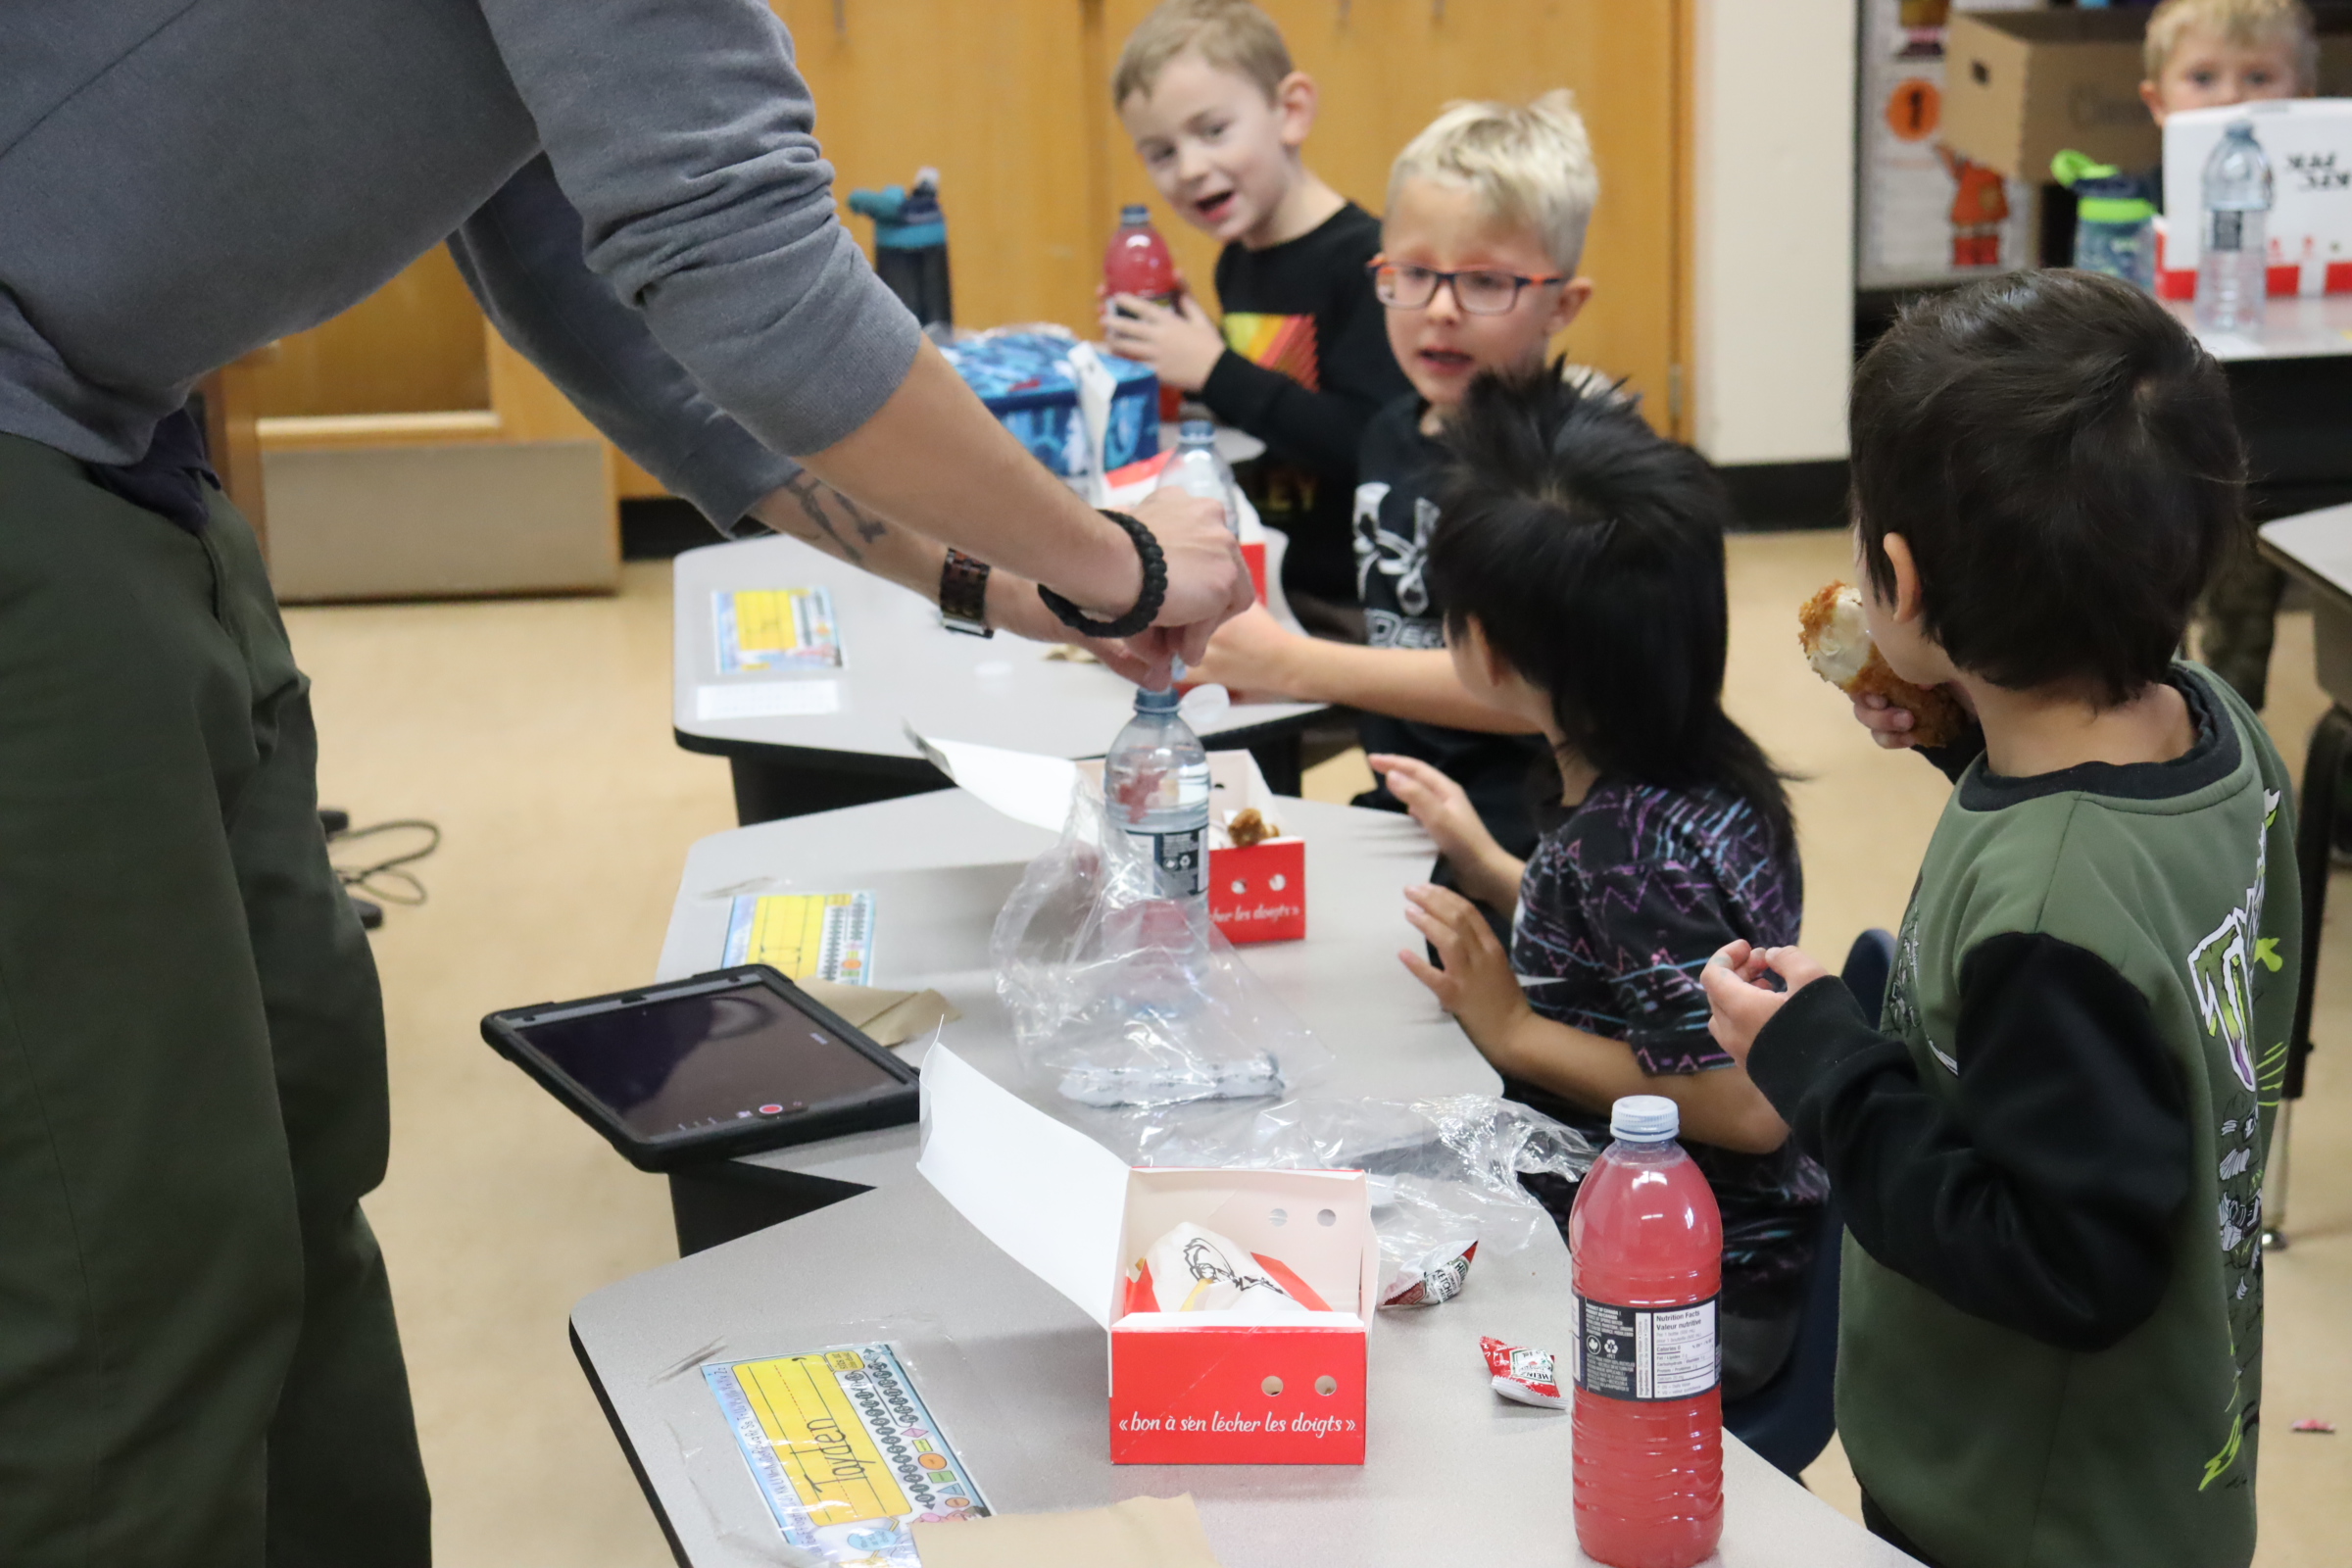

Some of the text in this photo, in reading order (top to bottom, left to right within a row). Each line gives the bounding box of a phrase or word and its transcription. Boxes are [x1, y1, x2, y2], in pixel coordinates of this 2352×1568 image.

[1436, 1270, 1453, 1297] KETCHU
[1455, 1262, 1466, 1285] HEIN
[1679, 1319, 1701, 1328] nutritive
[1131, 1411, 1160, 1432] bon
[1165, 1415, 1174, 1432] à
[1180, 1416, 1206, 1432] s'en
[1211, 1411, 1261, 1433] lécher
[1265, 1411, 1286, 1432] les
[1292, 1411, 1342, 1439] doigts
[790, 1417, 876, 1494] Tayden
